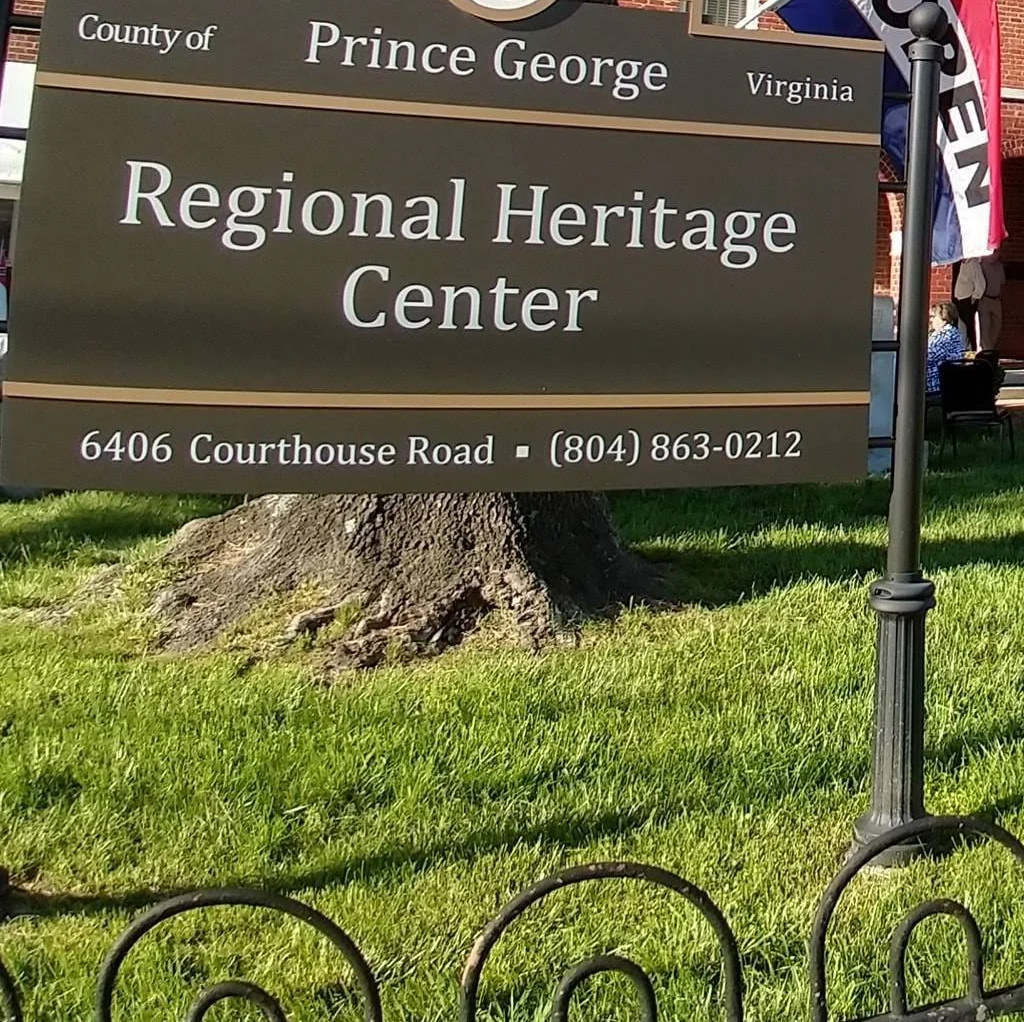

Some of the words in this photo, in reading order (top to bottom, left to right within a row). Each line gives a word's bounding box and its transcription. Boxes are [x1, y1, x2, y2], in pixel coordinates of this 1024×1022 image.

[78, 14, 182, 55] County
[185, 25, 218, 51] of
[304, 20, 476, 76] Prince
[493, 38, 669, 101] George
[746, 72, 854, 105] Virginia
[119, 160, 465, 251] Regional
[491, 183, 798, 269] Heritage
[341, 264, 598, 332] Center
[80, 430, 172, 463] 6406
[190, 433, 396, 466] Courthouse
[406, 435, 494, 465] Road
[550, 429, 640, 468] (804)
[650, 430, 802, 462] 863-0212
